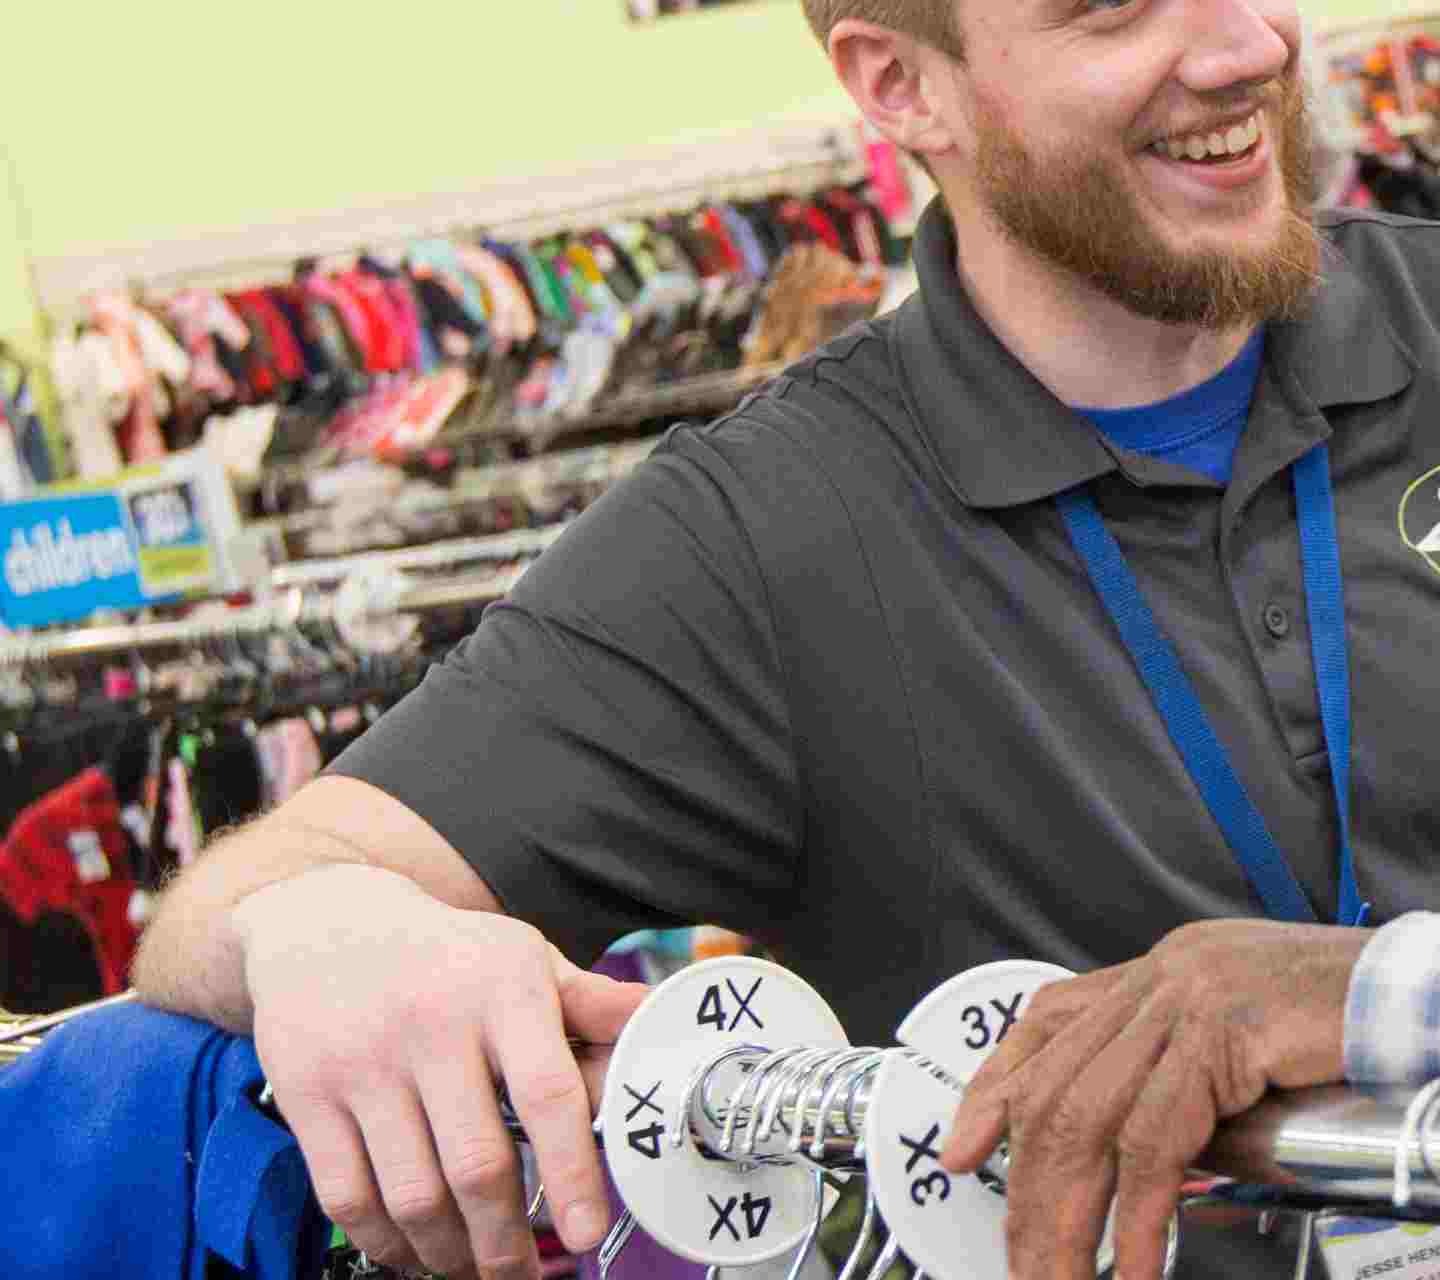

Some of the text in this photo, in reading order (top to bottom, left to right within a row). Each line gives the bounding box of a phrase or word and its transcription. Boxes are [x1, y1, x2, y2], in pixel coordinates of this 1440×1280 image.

[4, 515, 134, 596] children
[695, 976, 764, 1032] 4X
[961, 991, 1025, 1050] 3X
[622, 1080, 665, 1160] 4X
[898, 1121, 951, 1207] 3X
[707, 1191, 773, 1242] 4X
[1354, 1255, 1404, 1280] JESSE
